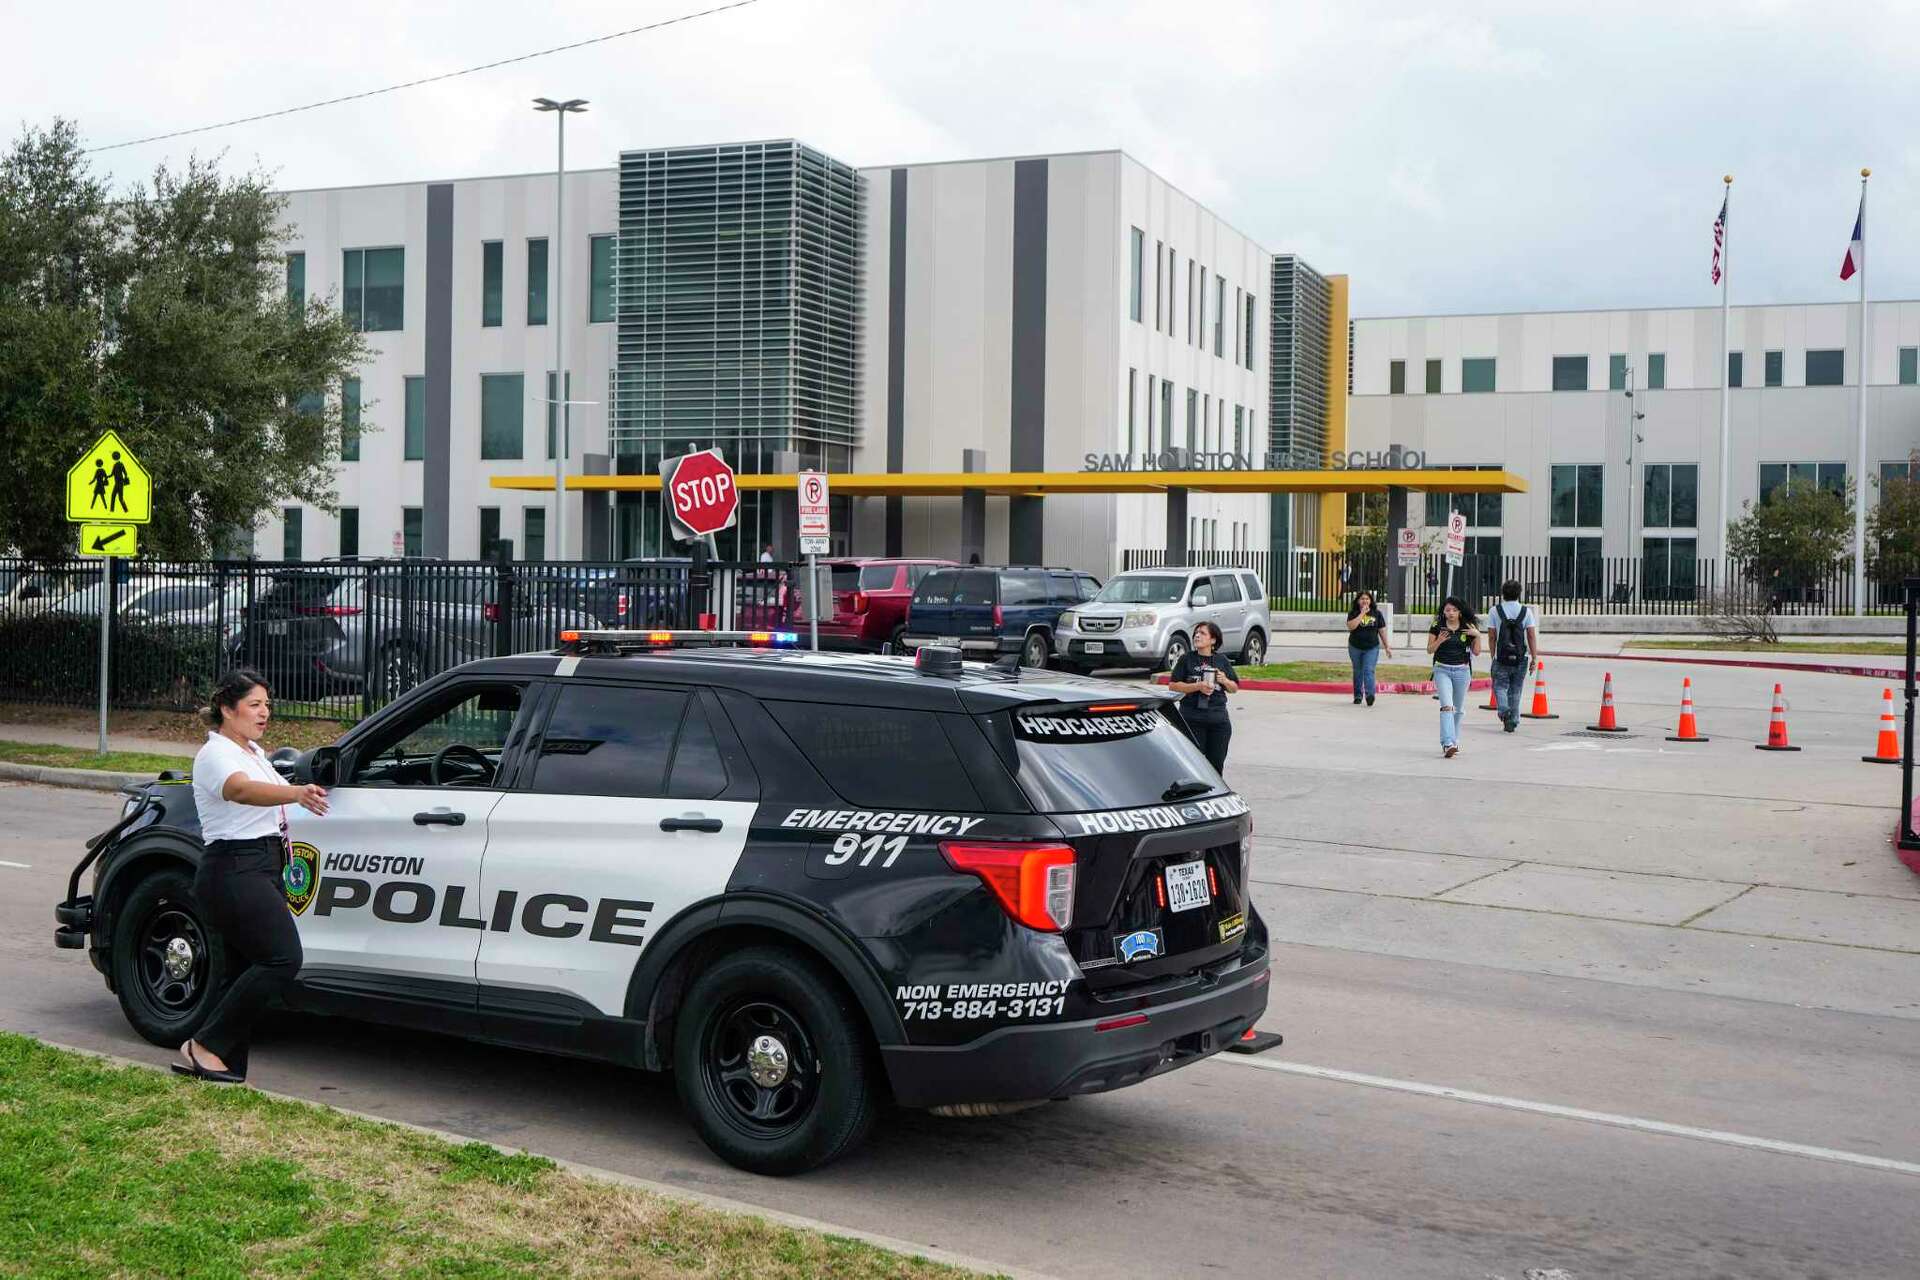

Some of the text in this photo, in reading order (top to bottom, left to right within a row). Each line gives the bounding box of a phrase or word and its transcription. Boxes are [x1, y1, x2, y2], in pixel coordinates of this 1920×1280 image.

[1084, 453, 1132, 471] SAM
[1141, 452, 1251, 471] HOUSTON
[1331, 451, 1428, 471] SCHOOL
[676, 473, 730, 512] STOP
[780, 808, 986, 836] EMERGENCY
[1076, 806, 1186, 834] HOUSTON
[824, 832, 910, 868] 911
[324, 852, 425, 876] HOUSTON
[1178, 866, 1194, 877] TEXAS
[313, 876, 655, 946] POLICE
[895, 979, 1072, 1000] NON EMERGENCY
[903, 996, 1066, 1020] 713-884-3131
